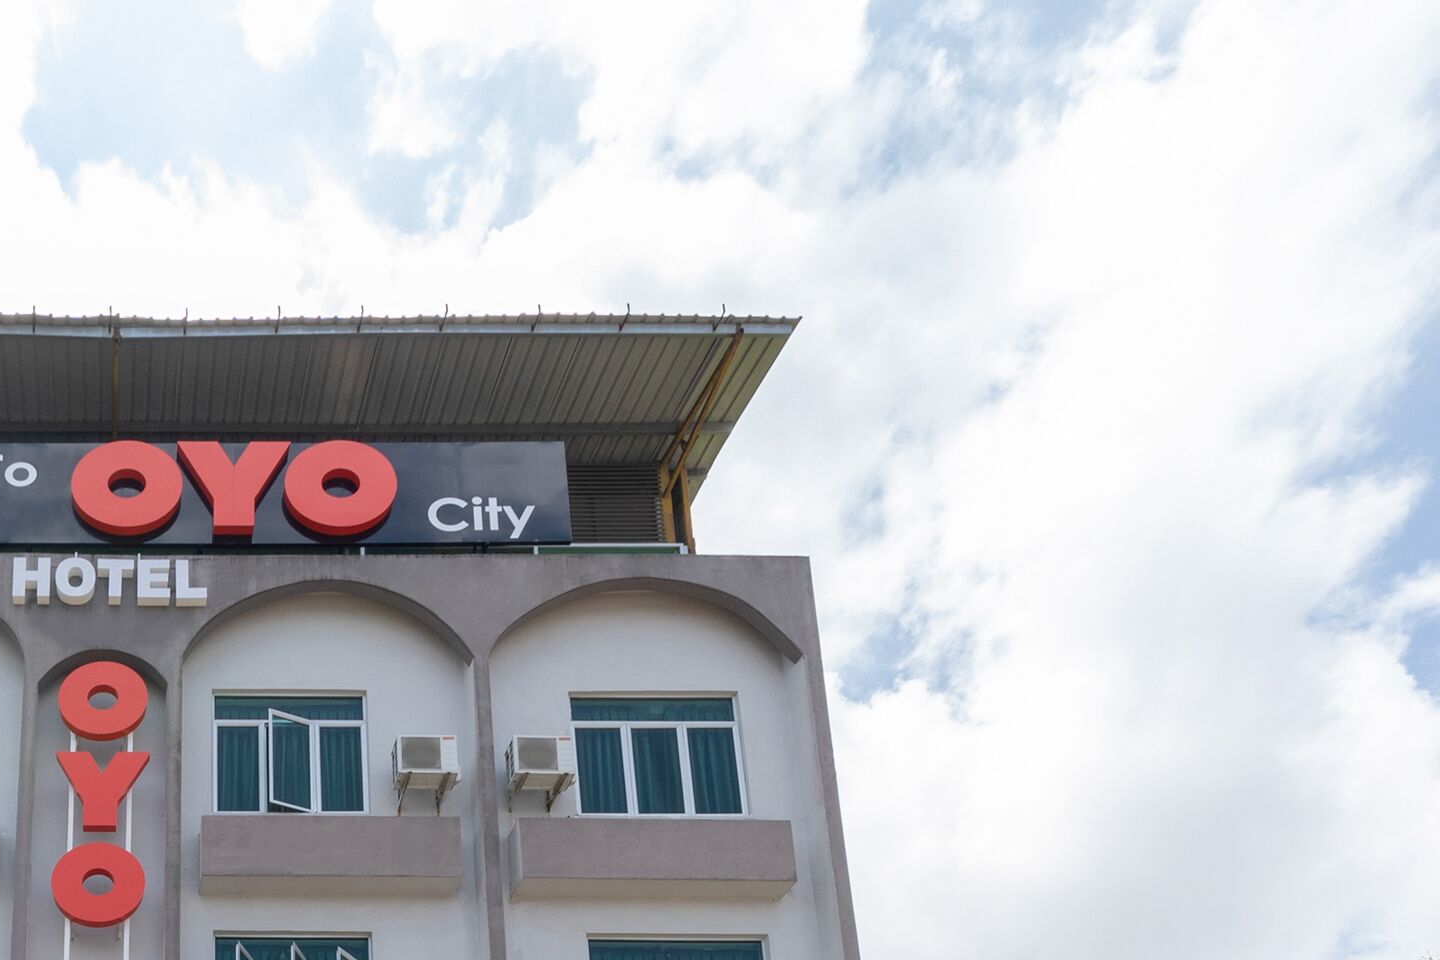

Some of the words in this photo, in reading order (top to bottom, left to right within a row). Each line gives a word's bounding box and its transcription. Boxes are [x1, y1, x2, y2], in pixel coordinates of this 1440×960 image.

[71, 440, 397, 536] OYO
[426, 496, 536, 539] City
[12, 556, 208, 607] HOTEL
[51, 660, 150, 928] OYO
